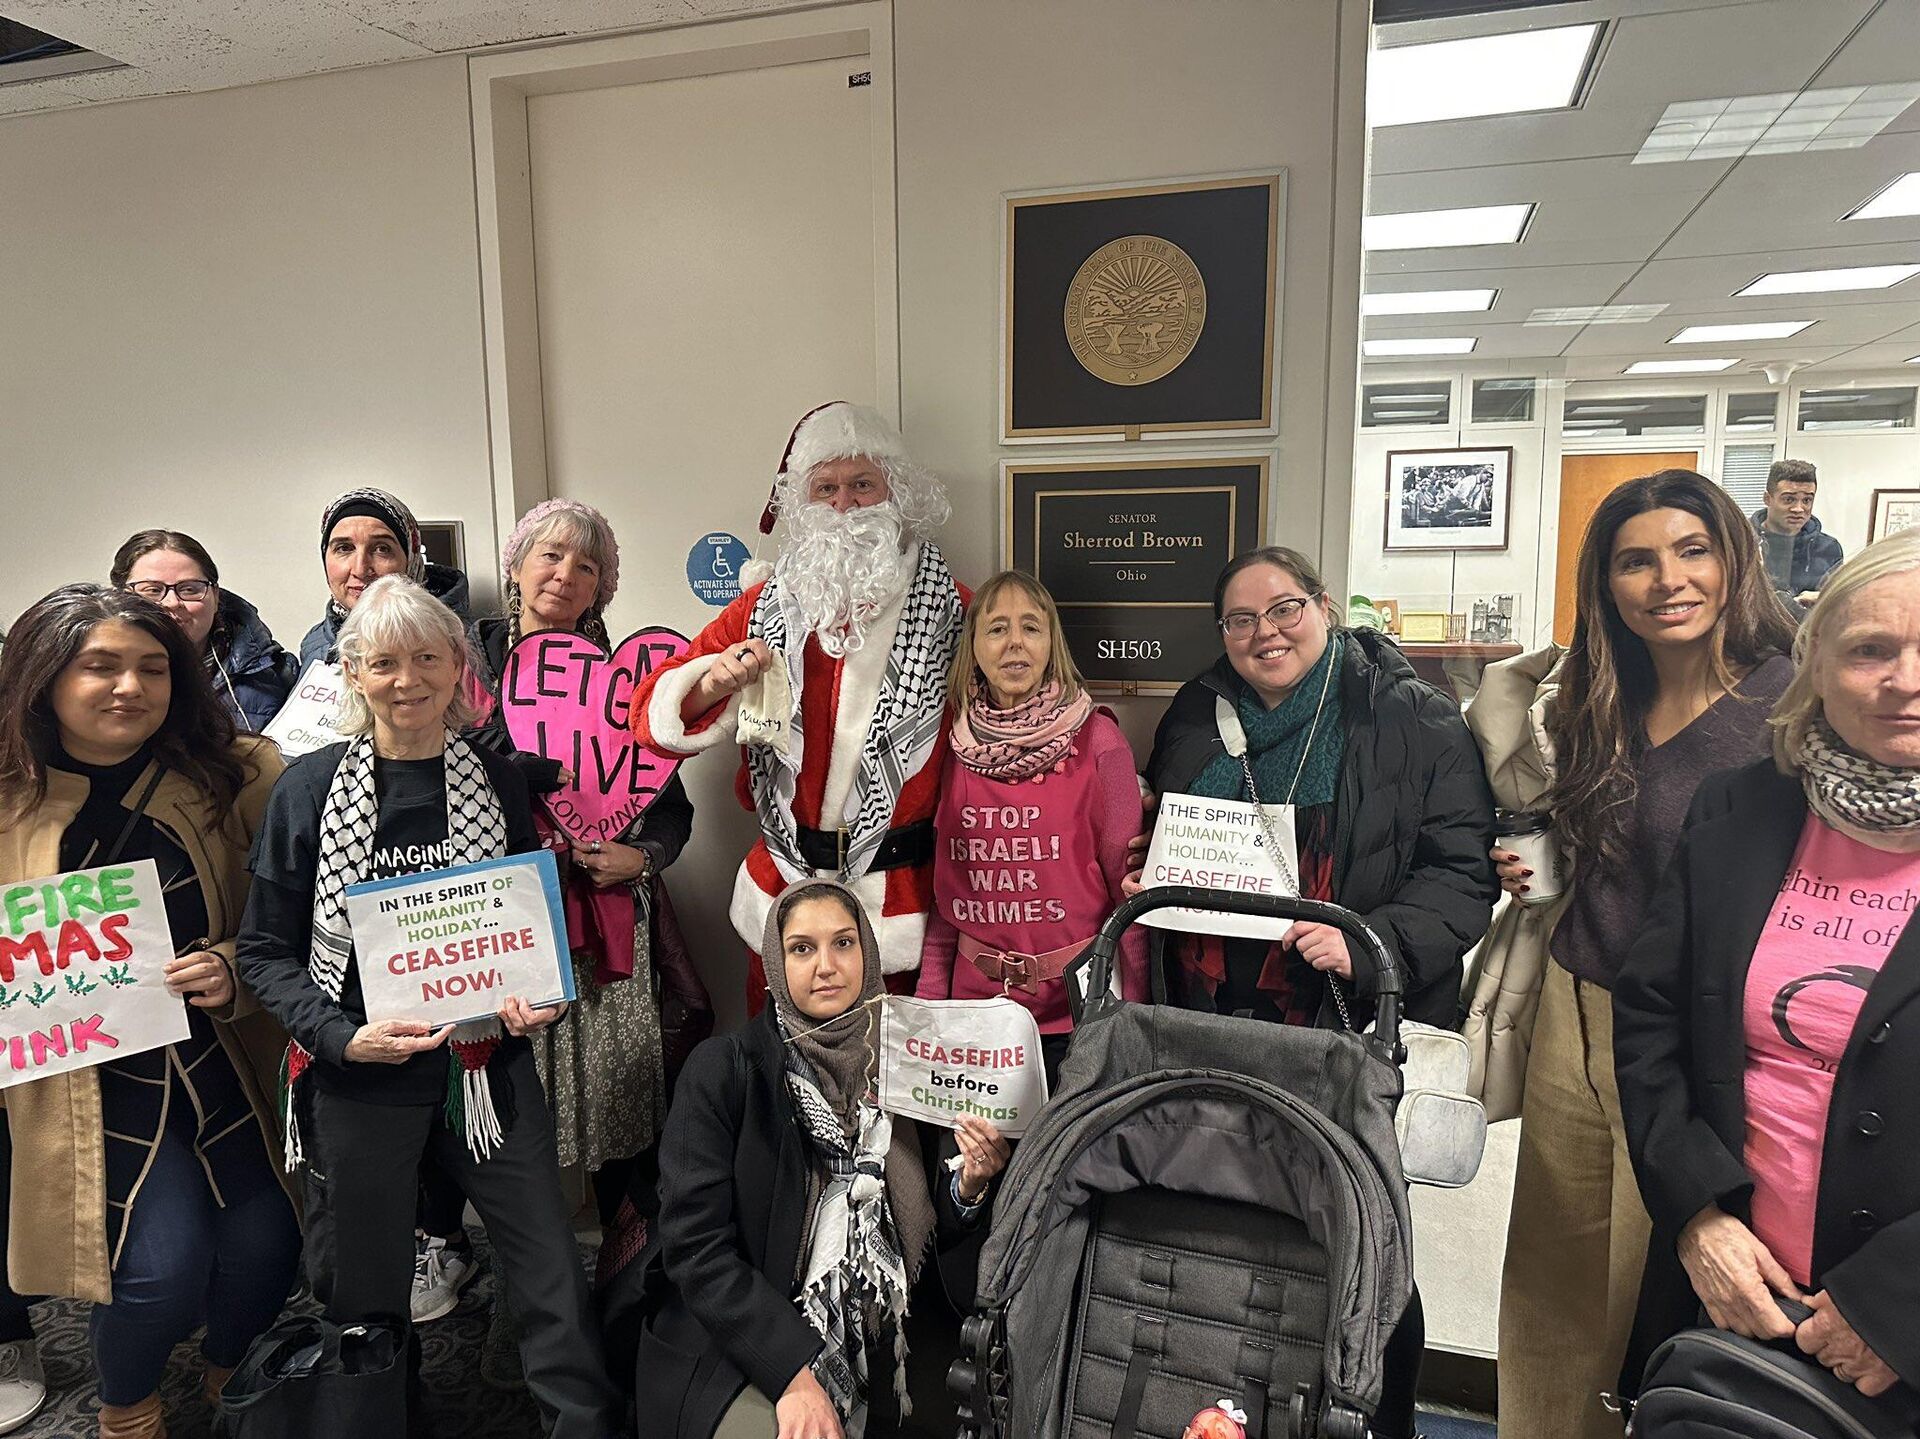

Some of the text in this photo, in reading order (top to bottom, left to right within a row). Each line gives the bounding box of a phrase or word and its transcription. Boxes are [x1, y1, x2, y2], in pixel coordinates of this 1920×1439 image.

[1069, 241, 1203, 360] THE GREAT SEAL OF THE STATE OF OHIO
[1108, 514, 1157, 524] SENATOR
[1063, 531, 1203, 549] Sherrod Brown
[693, 580, 723, 589] ACTIVATE
[1116, 570, 1147, 581] Ohio
[703, 589, 741, 599] TO OPERATE
[1097, 639, 1162, 660] SH503
[508, 639, 604, 706] LET
[961, 805, 1041, 829] STOP
[1168, 803, 1200, 820] THE
[1204, 808, 1258, 827] SPIRIT
[950, 835, 1060, 862] ISRAELI
[1164, 823, 1264, 848] HUMANITY &
[968, 869, 1039, 892] WAR
[1155, 864, 1273, 893] CEASEFIRE
[0, 867, 141, 935] FIRE
[379, 876, 513, 913] IN THE SPIRIT OF
[1850, 888, 1918, 912] each
[396, 897, 504, 927] HUMANITY &
[952, 898, 1066, 924] CRIMES
[407, 917, 499, 943] HOLIDAY...
[1777, 906, 1899, 948] is all of
[387, 927, 535, 976] CEASEFIRE
[421, 968, 504, 1002] NOW!
[905, 1038, 1025, 1069] CEASEFIRE
[930, 1070, 999, 1095] before
[911, 1086, 1018, 1120] Christmas
